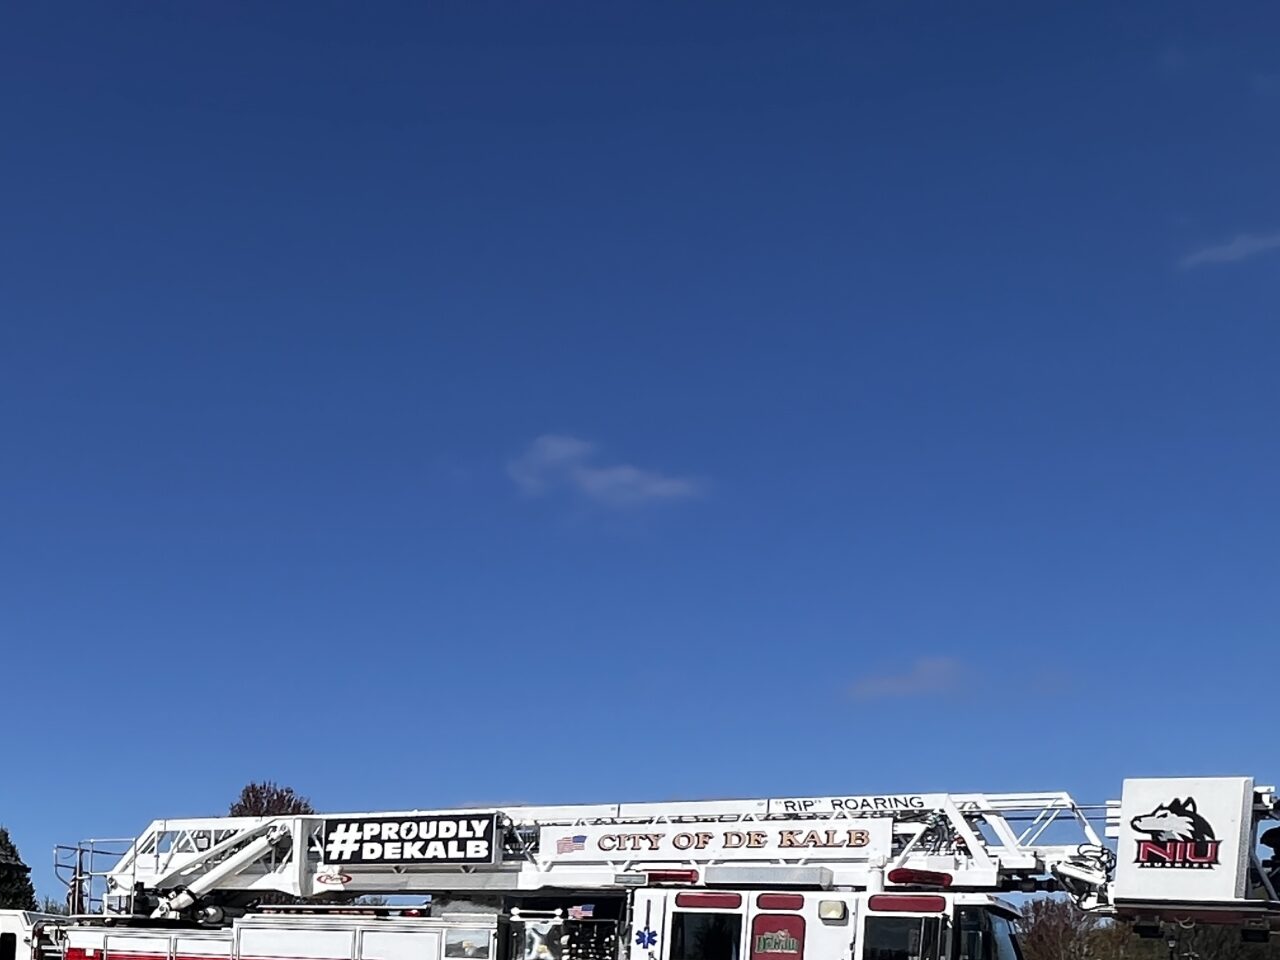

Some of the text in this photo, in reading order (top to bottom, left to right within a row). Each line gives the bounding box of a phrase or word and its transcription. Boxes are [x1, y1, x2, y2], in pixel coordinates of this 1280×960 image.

[830, 796, 925, 810] ROARING
[361, 840, 489, 860] DEKALB
[598, 829, 870, 851] CITY OF DE KALB
[1138, 841, 1218, 862] NIU
